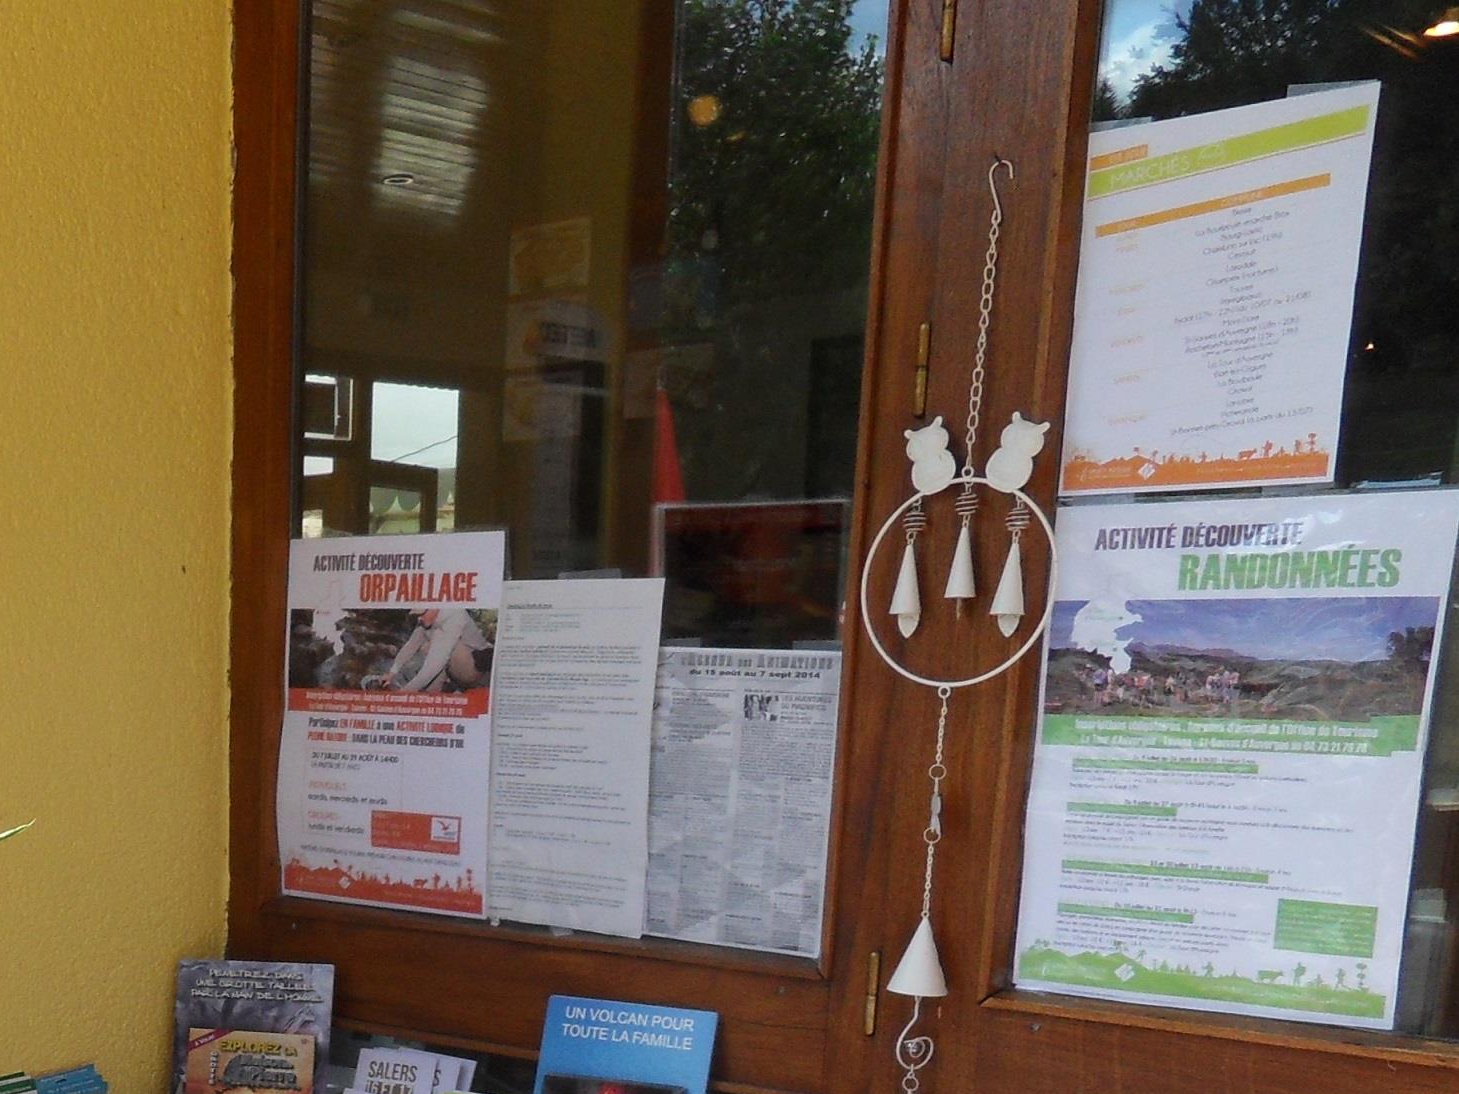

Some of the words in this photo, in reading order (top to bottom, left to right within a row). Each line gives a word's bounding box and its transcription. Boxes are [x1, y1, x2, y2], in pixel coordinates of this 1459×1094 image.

[1095, 523, 1177, 551] ACTIVITÉ
[1180, 521, 1304, 549] DÉCOUVERTE
[313, 552, 357, 572] ACTIVITÉ
[358, 551, 425, 570] DÉCOUVERTE
[1177, 545, 1403, 592] RANDONNÉES
[359, 572, 479, 604] ORPAILLAGE
[565, 1005, 586, 1021] UN
[589, 1007, 649, 1028] VOLCAN
[651, 1013, 695, 1032] POUR
[221, 1040, 282, 1053] EXPLOREZ
[561, 1024, 609, 1041] TOUTE
[613, 1028, 630, 1043] LA
[632, 1029, 693, 1050] FAMILLE
[368, 1060, 418, 1083] SALERS
